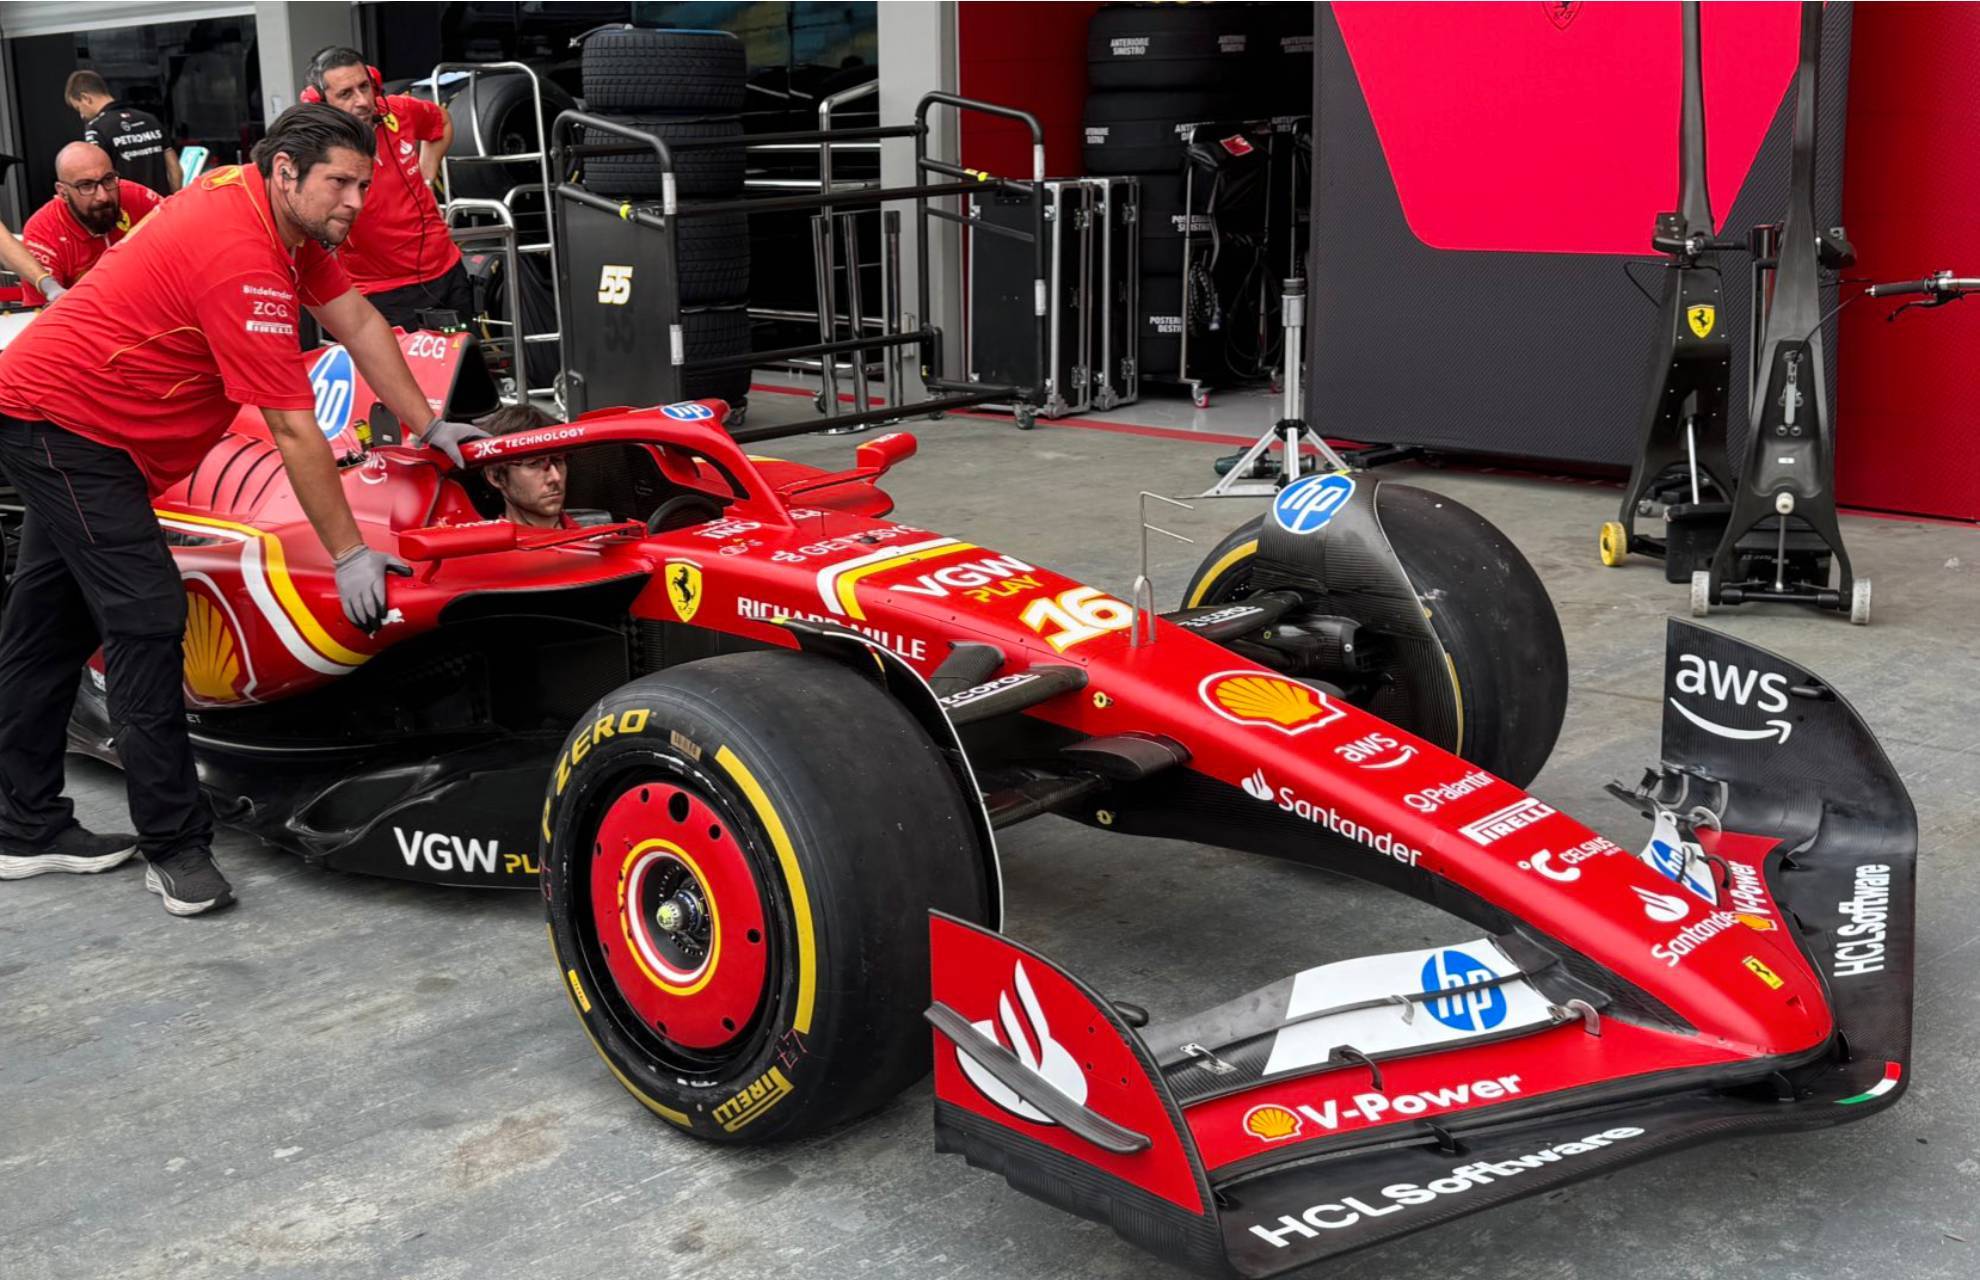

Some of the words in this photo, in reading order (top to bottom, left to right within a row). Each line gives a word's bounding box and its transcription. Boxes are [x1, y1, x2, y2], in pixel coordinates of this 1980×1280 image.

[253, 301, 288, 318] ZCG
[597, 265, 634, 306] 55
[407, 335, 446, 358] ZCG
[474, 437, 503, 458] DXC
[504, 427, 586, 449] TECHNOLOGY
[1280, 476, 1348, 531] hp
[888, 555, 1035, 597] VGW
[963, 574, 1044, 603] PLAY
[1018, 585, 1134, 654] 16
[1676, 653, 1790, 713] aws
[555, 708, 651, 796] ZERO
[1334, 732, 1398, 763] aws
[1421, 771, 1495, 805] Palantir
[1278, 788, 1422, 867] Santander
[1458, 797, 1557, 846] PIRELLI
[393, 827, 499, 873] VGW
[503, 854, 542, 873] PL
[1559, 836, 1616, 864] CELSIUS
[1728, 861, 1771, 914] V-Power
[1833, 864, 1891, 977] HCLSoftware
[1435, 949, 1494, 1031] hp
[712, 1066, 794, 1132] PIRELLI
[1298, 1071, 1522, 1130] V-Power
[1249, 1124, 1645, 1248] HCLSoftware
